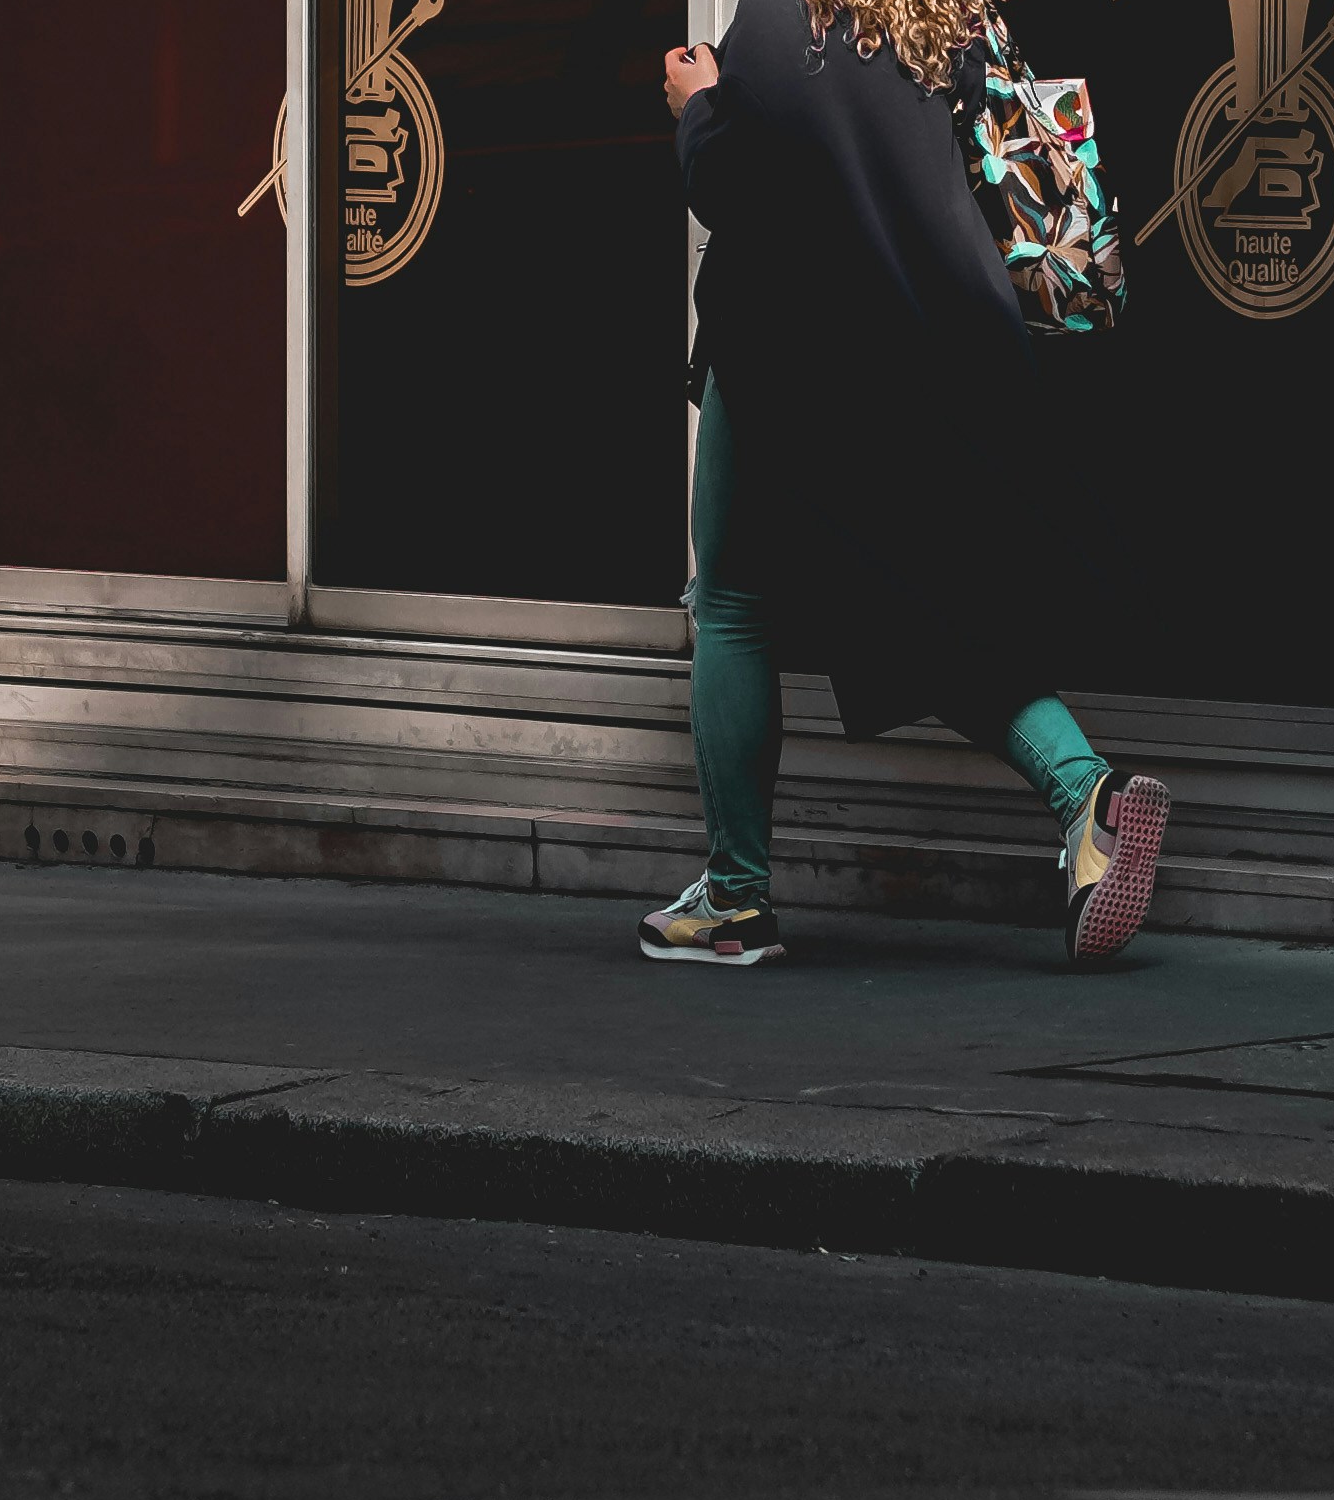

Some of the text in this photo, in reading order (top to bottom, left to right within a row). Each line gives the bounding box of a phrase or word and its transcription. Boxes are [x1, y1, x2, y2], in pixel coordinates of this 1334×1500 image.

[346, 204, 377, 226] ute
[346, 228, 384, 254] alité
[1235, 229, 1292, 255] haute
[1228, 257, 1299, 284] Qualité
